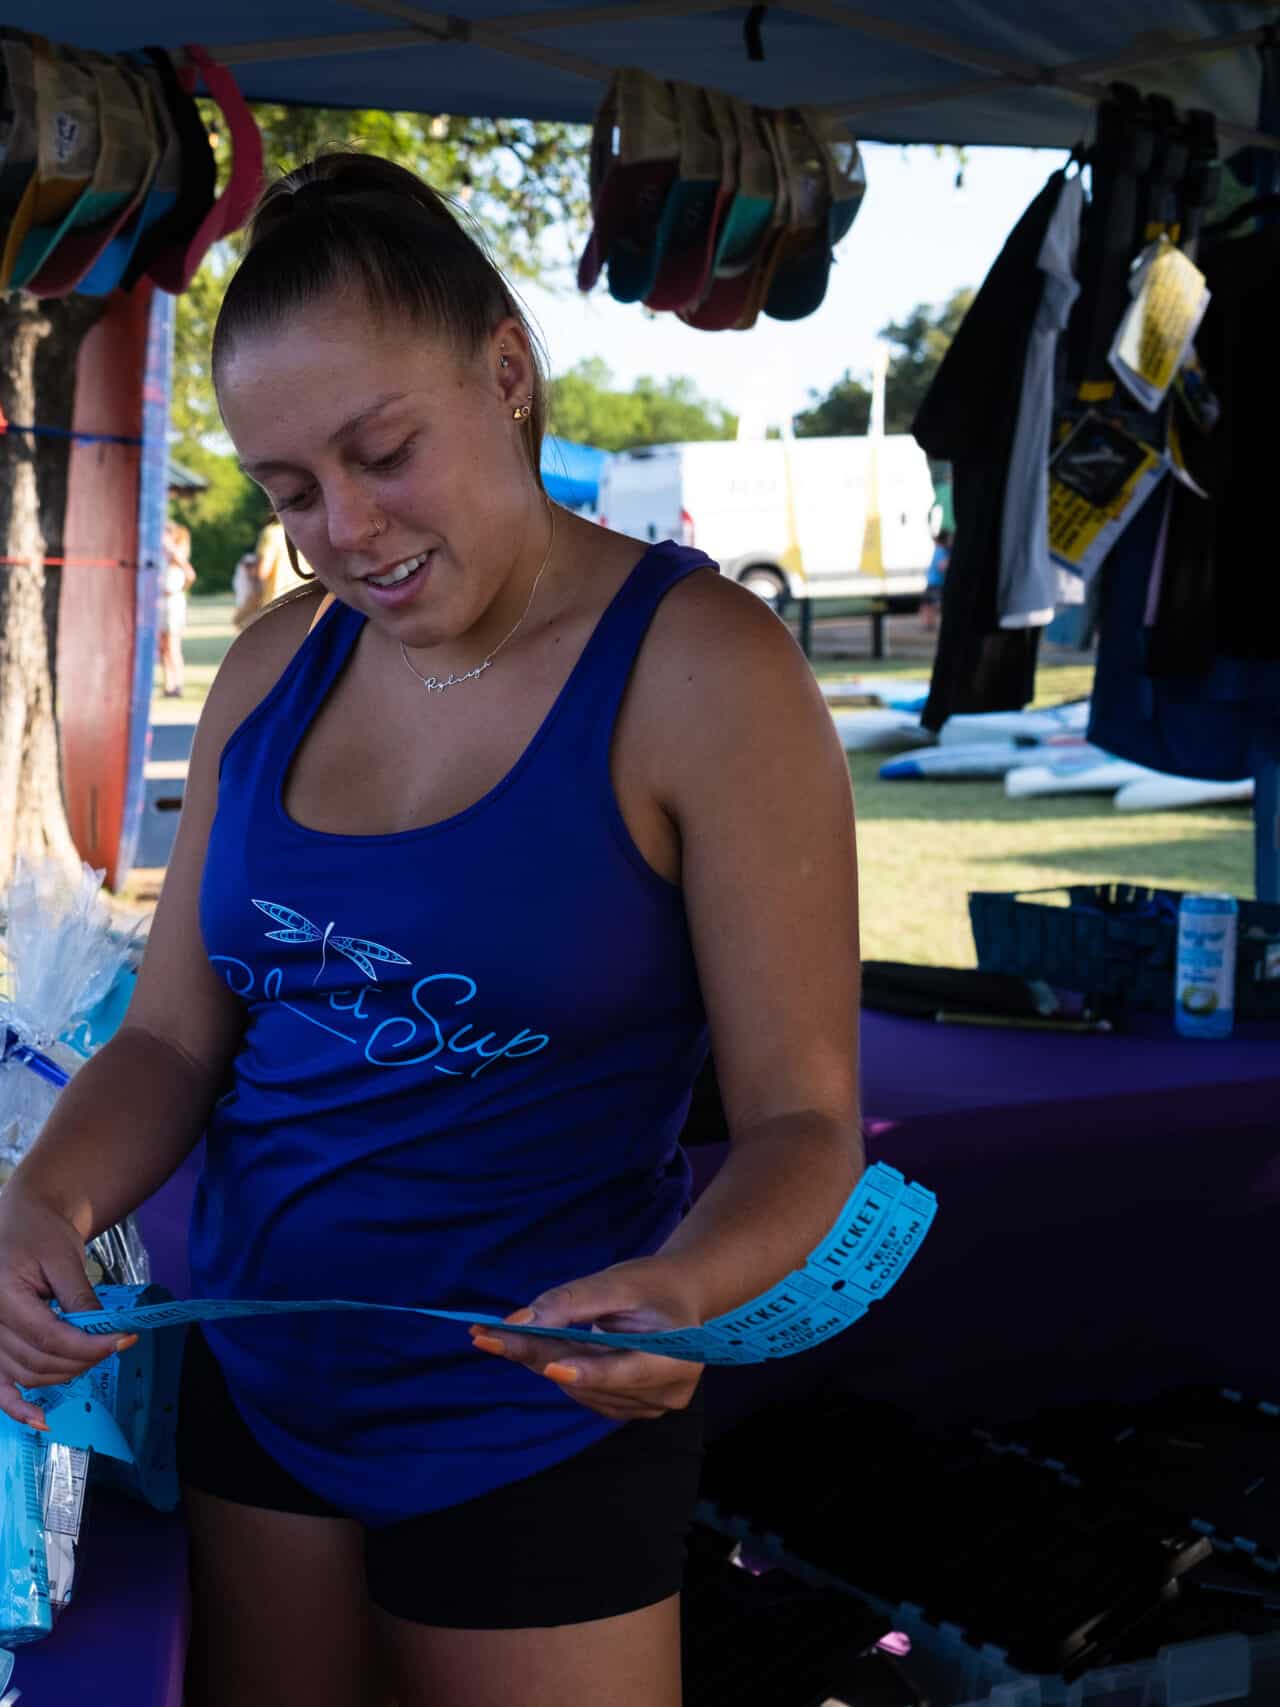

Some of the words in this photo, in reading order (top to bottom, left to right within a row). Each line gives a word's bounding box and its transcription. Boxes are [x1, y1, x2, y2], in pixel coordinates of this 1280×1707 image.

[823, 1197, 881, 1268] TICKET
[864, 1225, 898, 1272] KEEP
[870, 1220, 921, 1291] COUPON
[724, 1292, 797, 1334] TICKET
[767, 1316, 812, 1342] KEEP
[769, 1316, 841, 1353] COUPON
